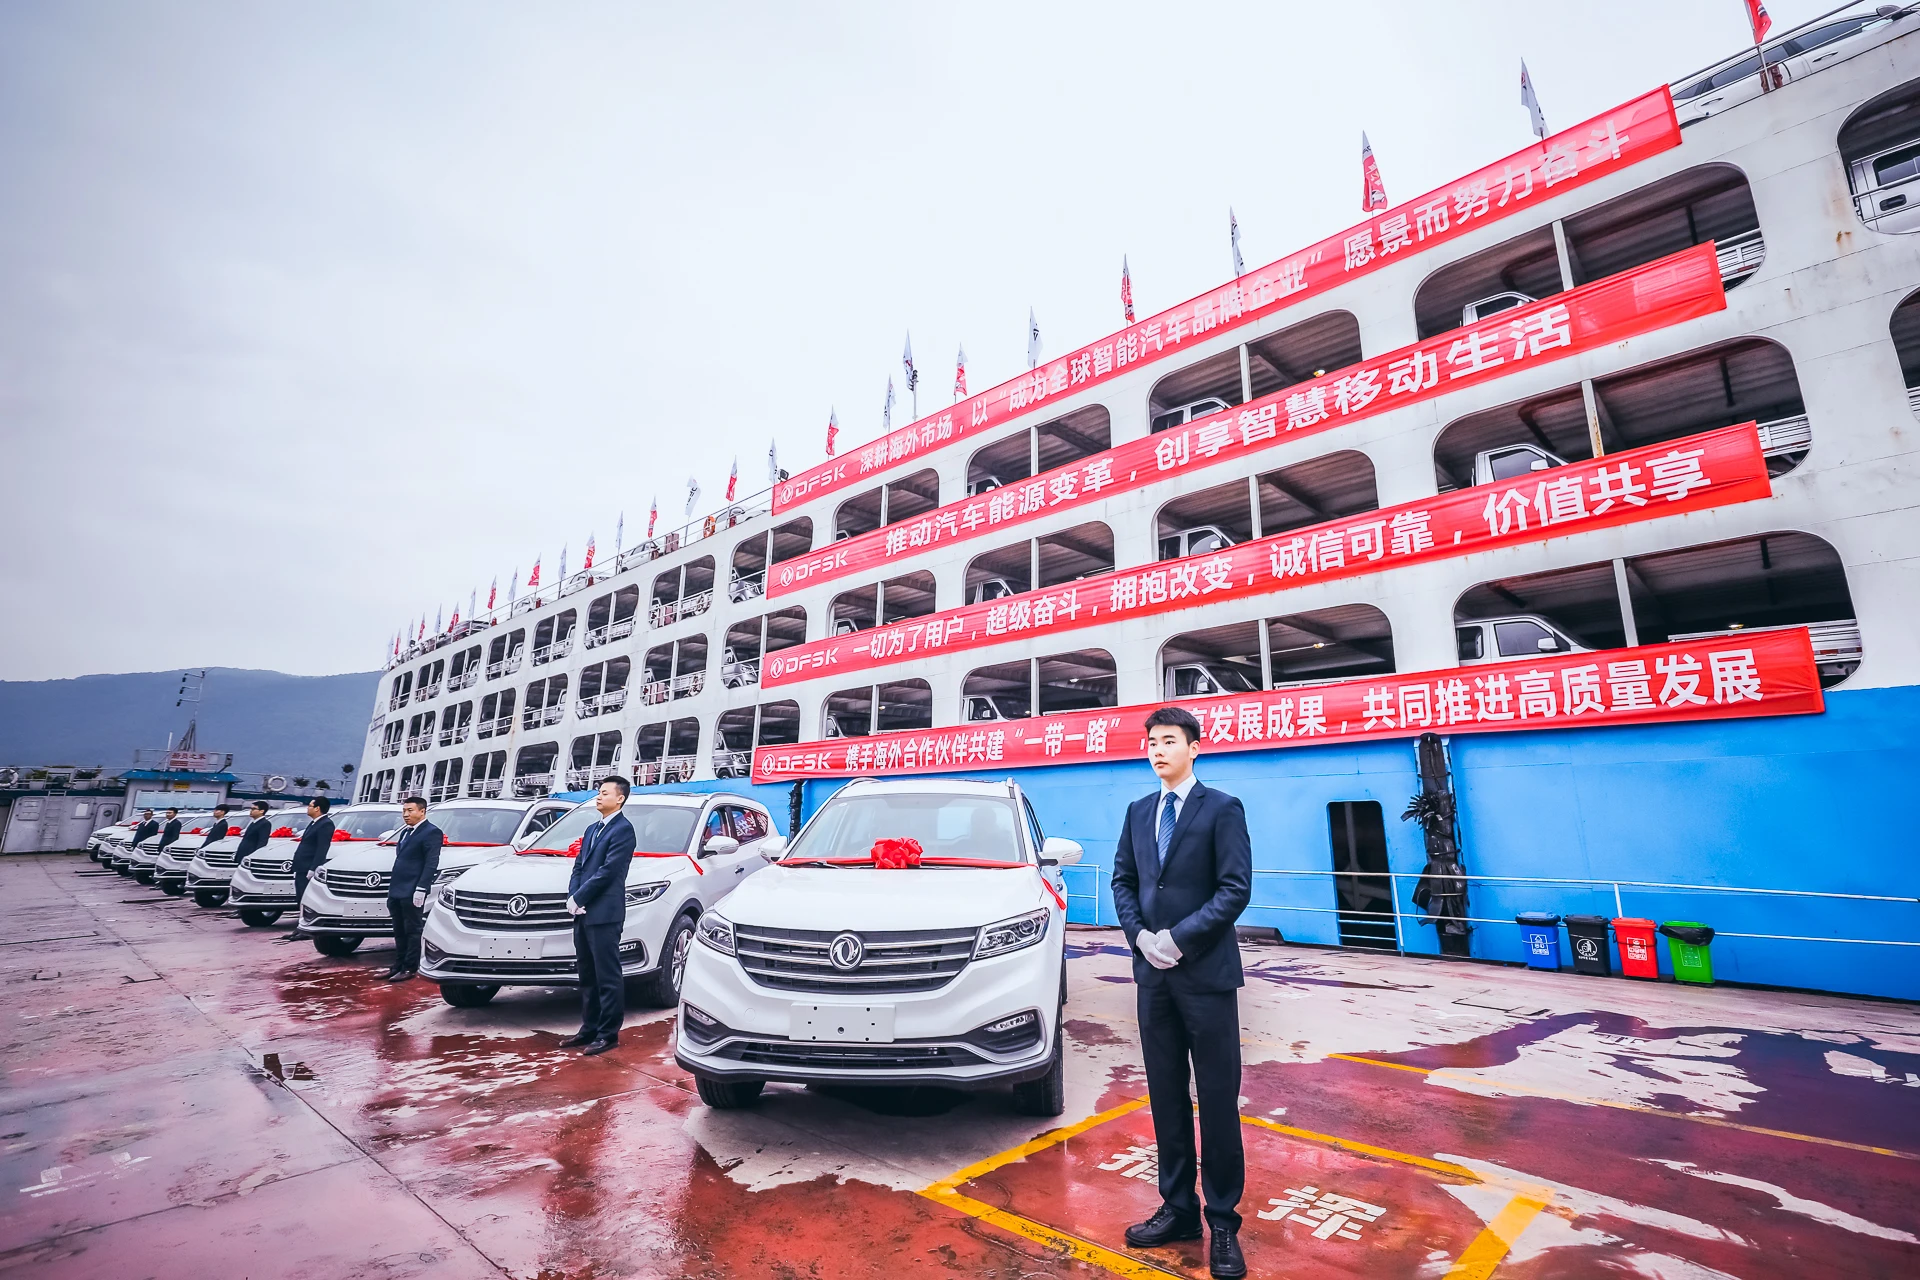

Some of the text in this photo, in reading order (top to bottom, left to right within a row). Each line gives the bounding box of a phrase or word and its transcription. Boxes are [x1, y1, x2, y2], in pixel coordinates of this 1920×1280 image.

[795, 463, 848, 497] DFSK
[795, 550, 849, 581] DFSK
[785, 647, 839, 674] DFSK
[777, 752, 832, 771] DFSK
